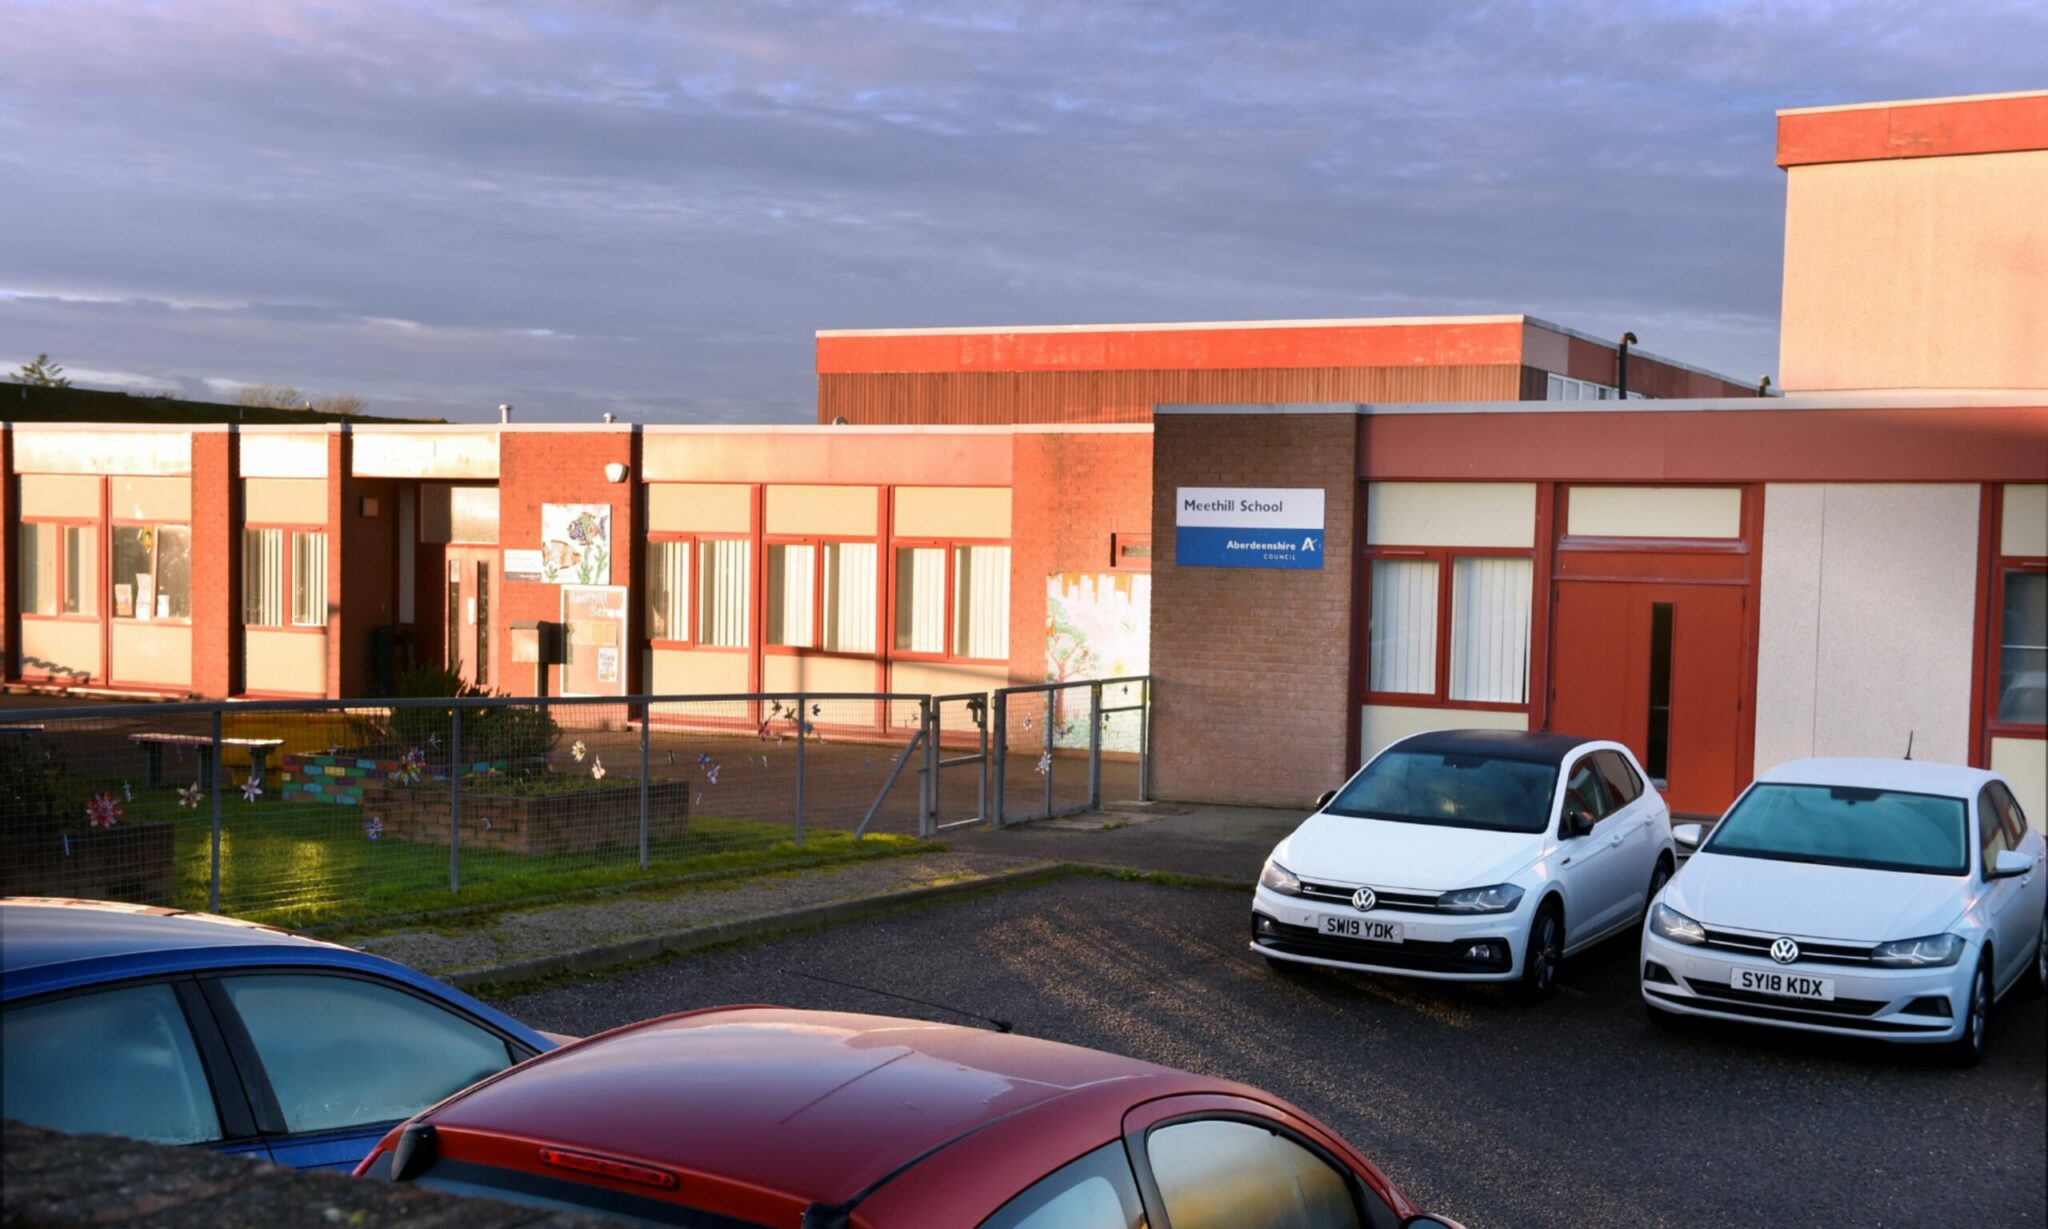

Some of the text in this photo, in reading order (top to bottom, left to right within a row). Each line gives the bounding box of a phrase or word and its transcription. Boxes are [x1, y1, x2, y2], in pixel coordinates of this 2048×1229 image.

[1184, 499, 1283, 512] Meethill School
[1226, 540, 1296, 550] Aberdeenshire
[1327, 918, 1394, 939] SW19 YDK
[1742, 971, 1822, 996] SY18 KDX
